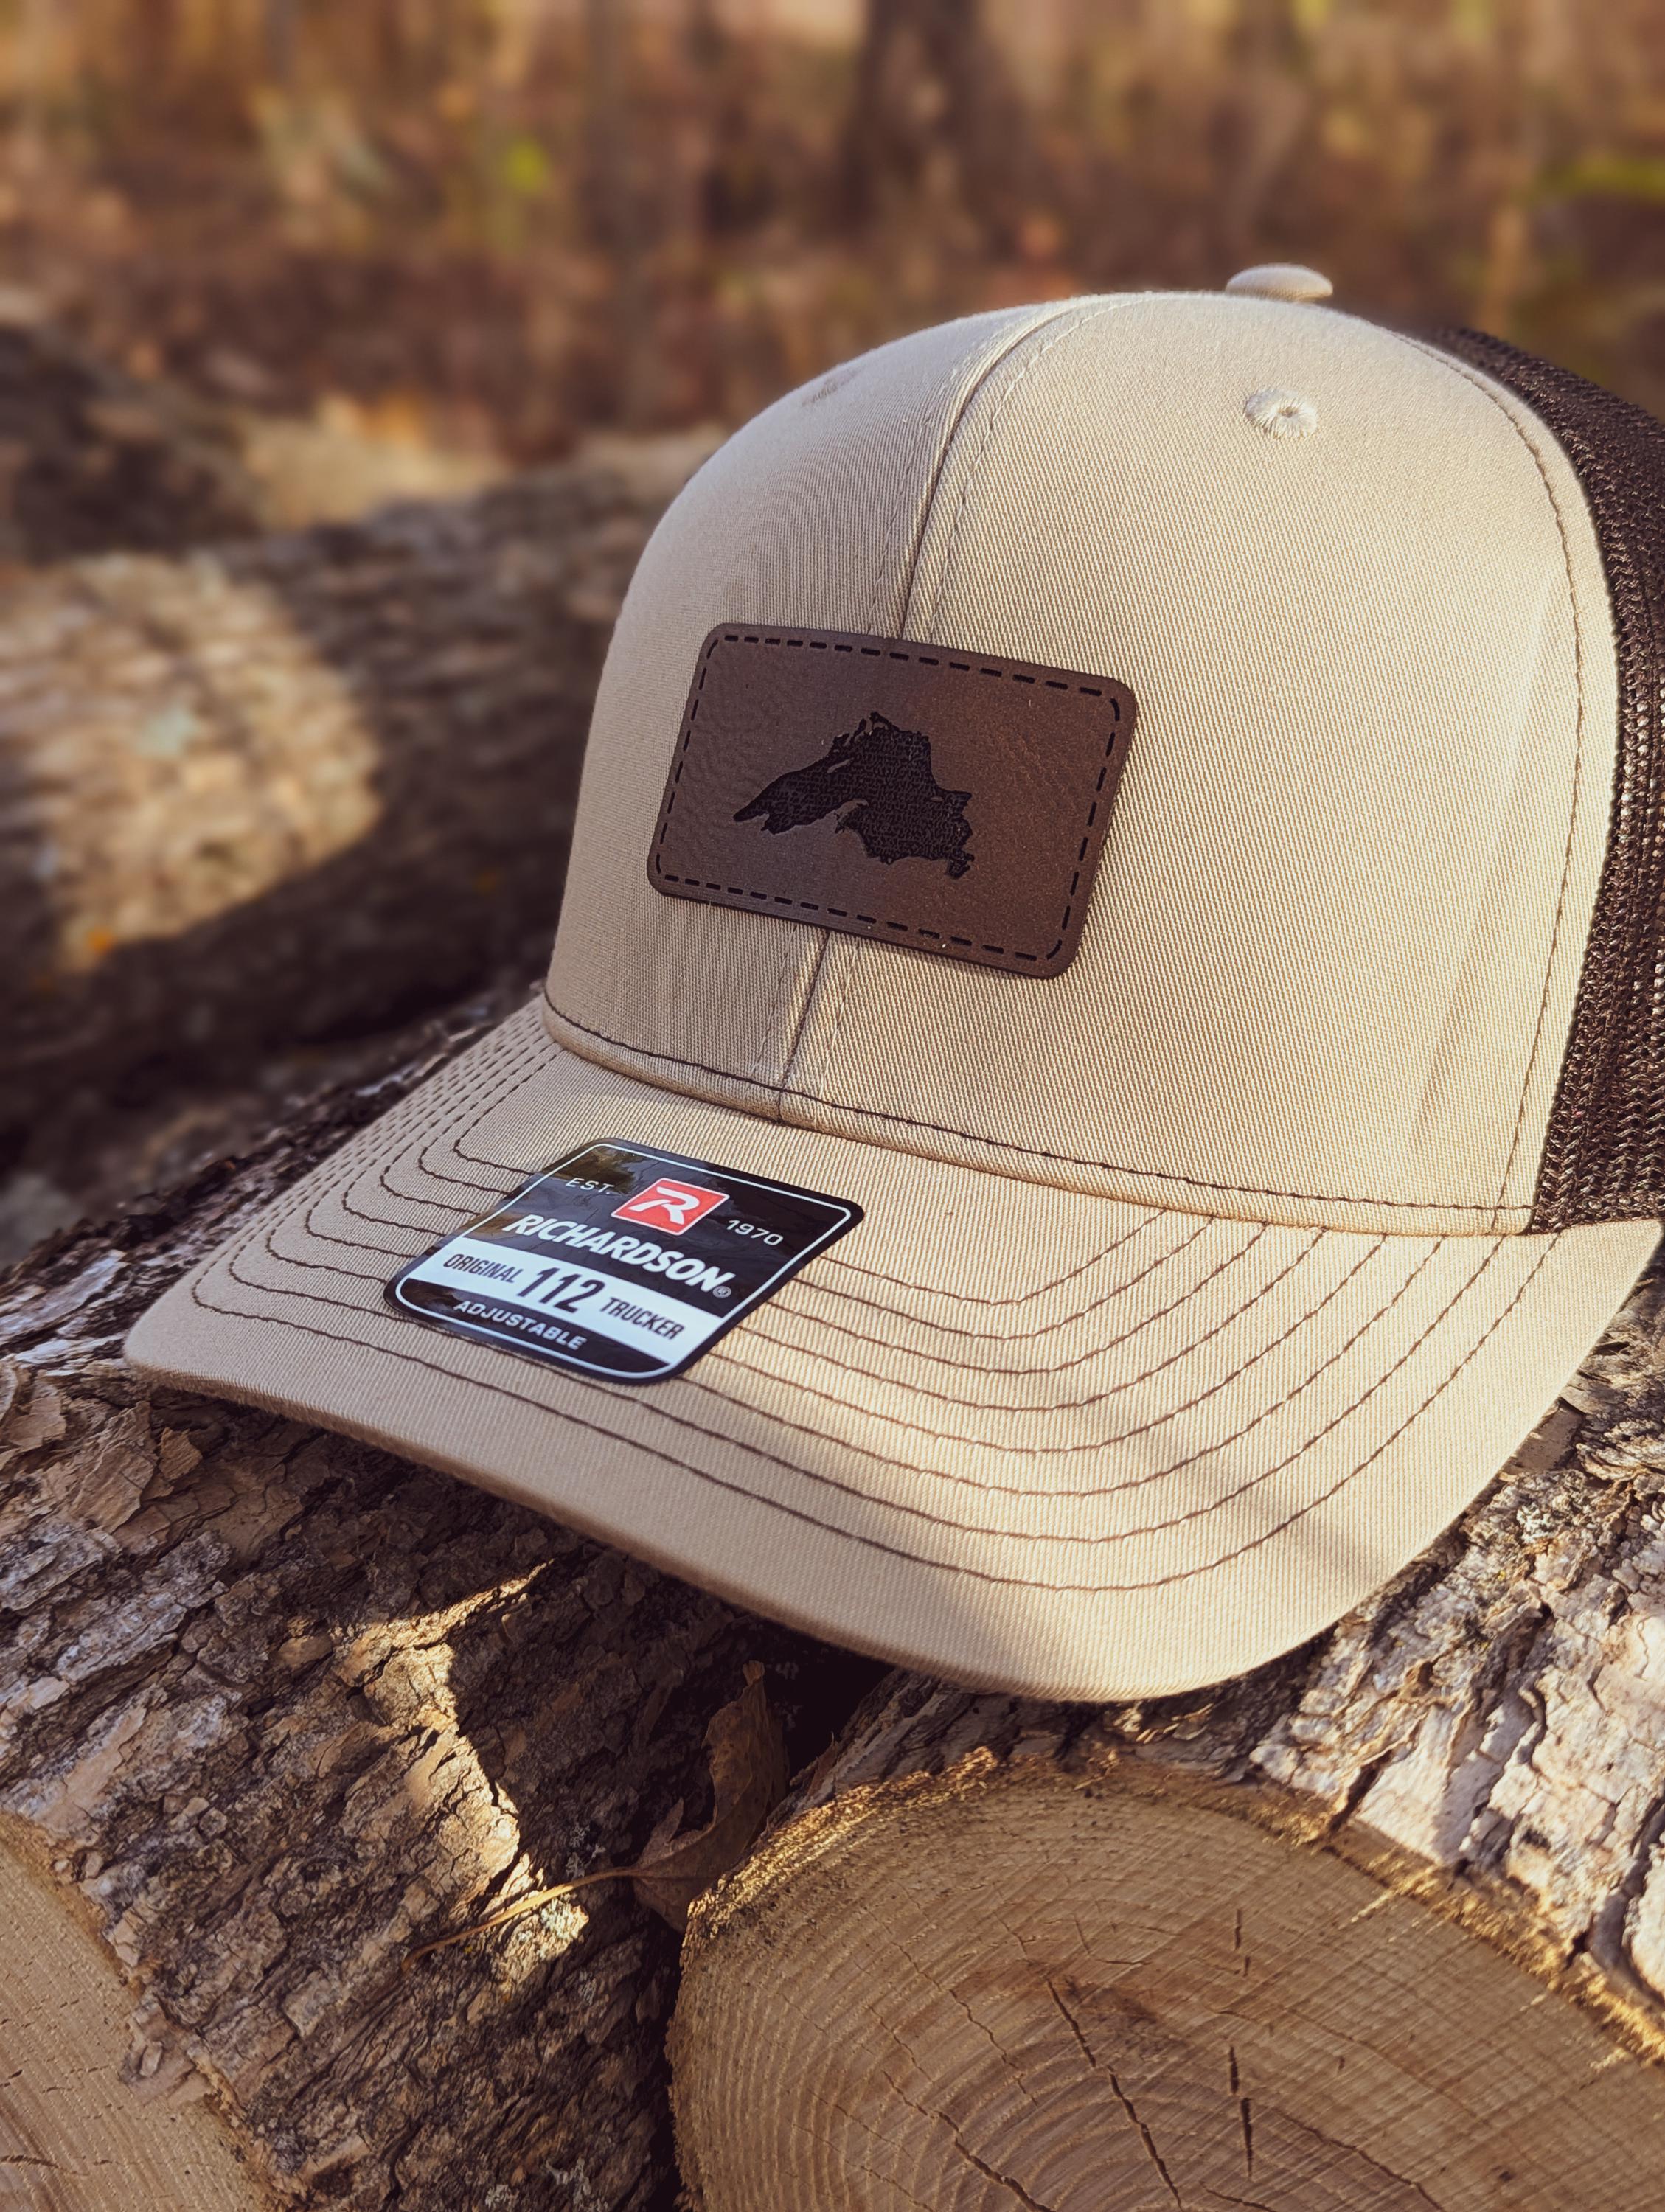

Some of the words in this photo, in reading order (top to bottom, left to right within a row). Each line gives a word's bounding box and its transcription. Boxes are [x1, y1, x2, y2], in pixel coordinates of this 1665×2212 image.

[566, 1177, 614, 1194] EST.
[726, 1220, 784, 1246] 1970
[628, 1186, 700, 1225] R
[444, 1253, 522, 1283] ORIGINAL
[517, 1267, 605, 1313] 112
[599, 1298, 685, 1340] TRUCKER
[454, 1300, 587, 1350] ADJUSTABLE
